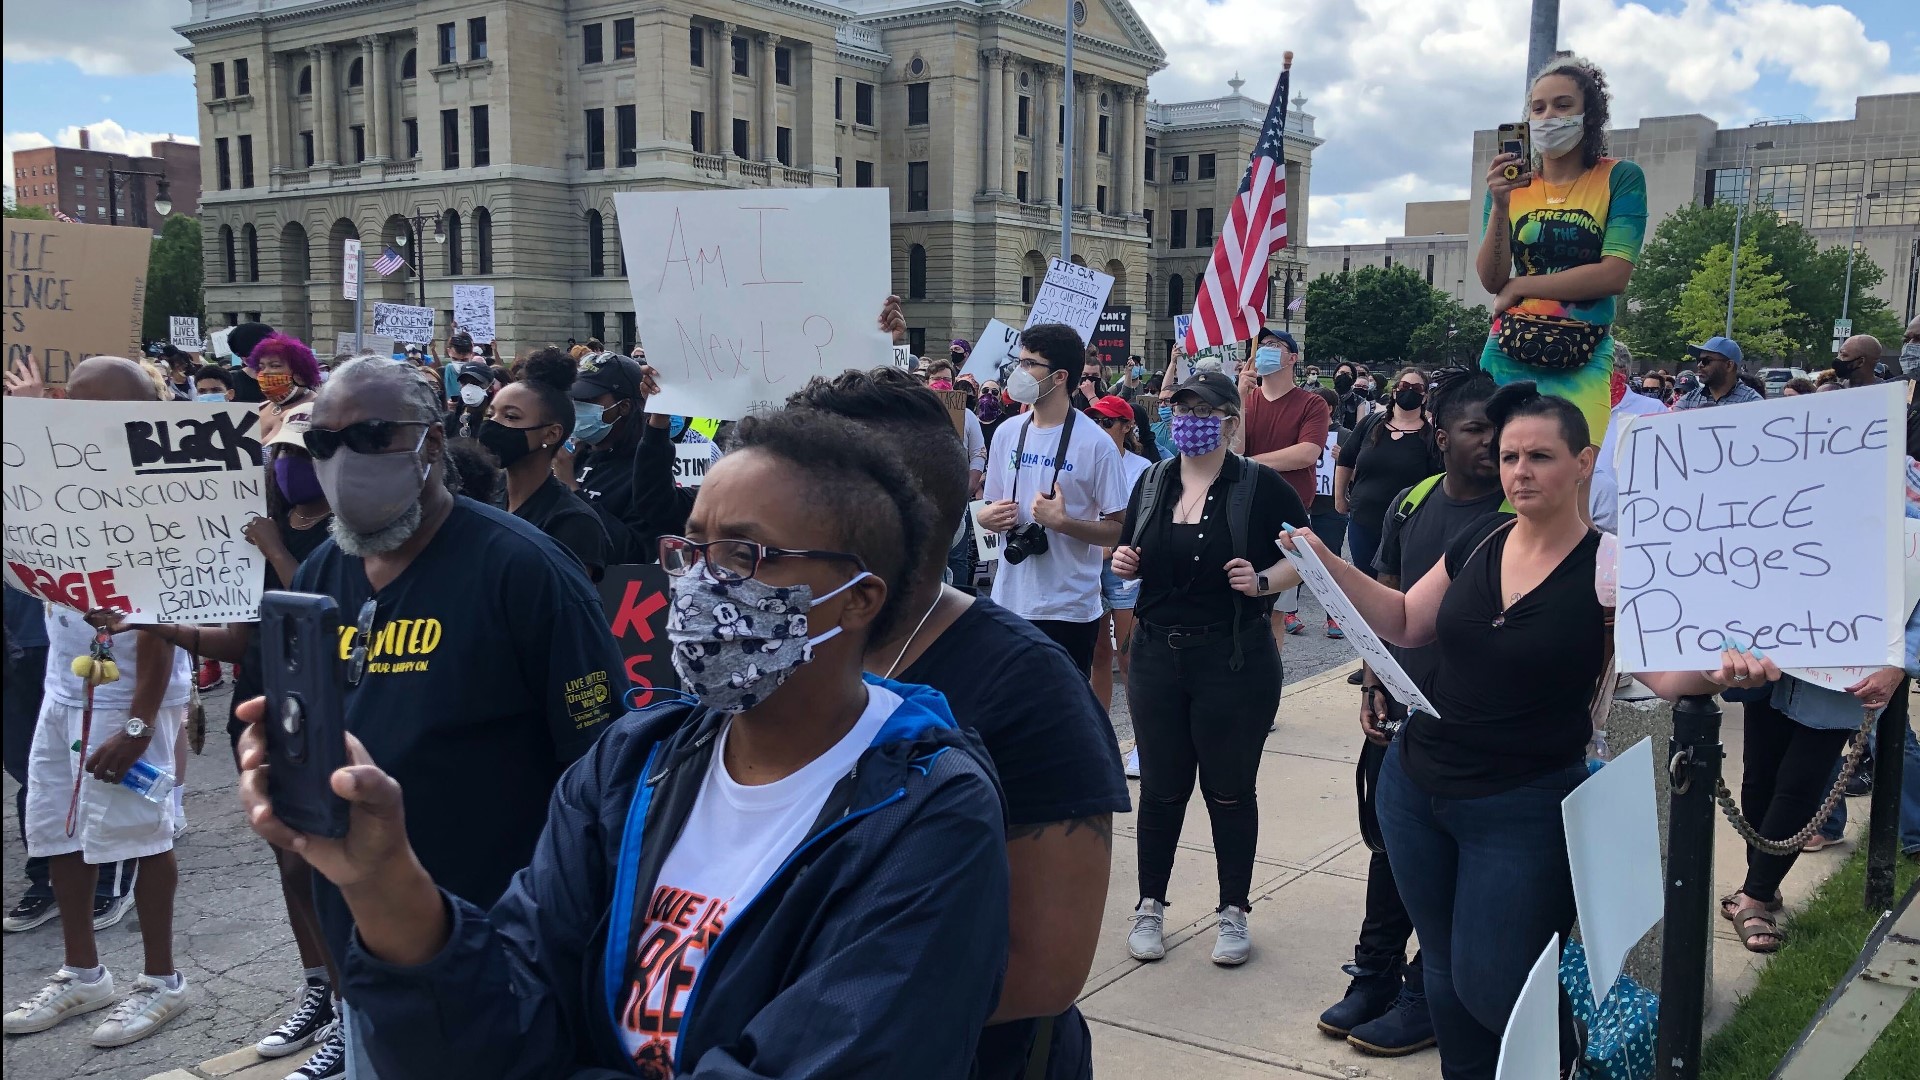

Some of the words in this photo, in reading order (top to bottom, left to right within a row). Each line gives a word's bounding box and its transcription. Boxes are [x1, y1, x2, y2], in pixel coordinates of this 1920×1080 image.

[1527, 210, 1599, 235] SPREADING
[1552, 228, 1580, 241] THE
[738, 206, 804, 286] I
[1045, 270, 1101, 295] RESPONSIBILITY
[1053, 259, 1075, 275] ITS
[1077, 267, 1095, 281] OUR
[3, 274, 74, 311] ENCE
[1042, 286, 1056, 298] TO
[1060, 290, 1100, 310] QUESTION
[173, 317, 196, 326] BLACK
[384, 314, 430, 327] CONSENT
[1036, 298, 1095, 329] SYSTEMIC
[1101, 311, 1127, 321] CAN'T
[1177, 315, 1190, 327] NO
[174, 326, 196, 337] LIVES
[1099, 324, 1126, 332] UNTIL
[172, 338, 198, 347] MATTER
[675, 314, 786, 384] Next
[3, 442, 25, 467] o
[46, 426, 107, 471] be
[125, 410, 264, 472] BLacK
[575, 466, 594, 483] I
[1041, 455, 1073, 472] Toldo
[55, 479, 219, 513] CONSCIOUS
[232, 479, 259, 500] IN
[1622, 484, 1825, 537] POLICE
[66, 525, 91, 550] IS
[99, 520, 134, 546] to
[146, 514, 186, 542] be
[197, 515, 232, 541] IN
[106, 546, 182, 569] state
[196, 540, 235, 565] of
[1620, 537, 1832, 589] JudgeS
[158, 588, 251, 616] BaLDWIN
[611, 580, 668, 643] K
[1620, 588, 1883, 667] Prosector
[565, 677, 585, 692] LIVE
[645, 884, 708, 929] WE
